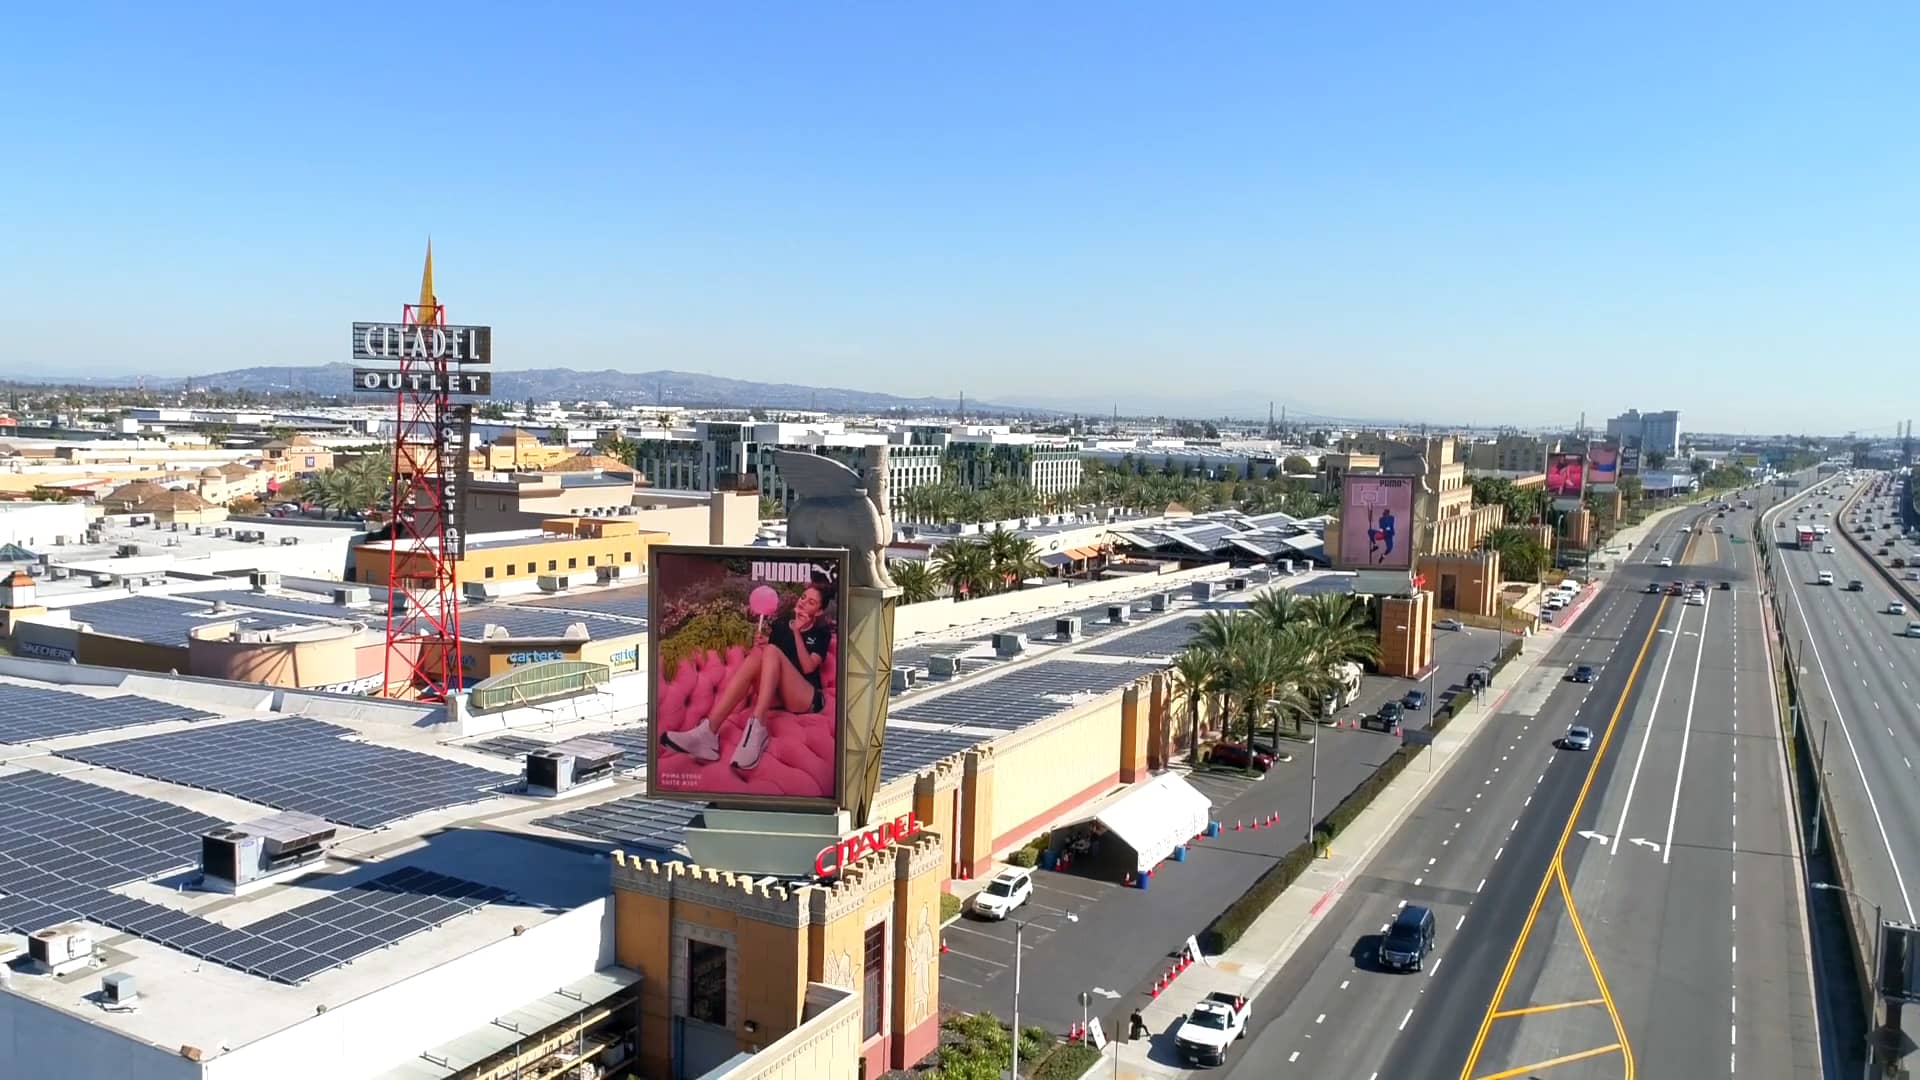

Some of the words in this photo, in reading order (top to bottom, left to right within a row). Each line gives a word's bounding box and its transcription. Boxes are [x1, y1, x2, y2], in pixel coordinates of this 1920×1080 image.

[364, 326, 480, 360] CITADEL
[364, 373, 481, 392] OUTLET
[751, 562, 812, 583] PUMA
[815, 811, 921, 878] CITADEL
